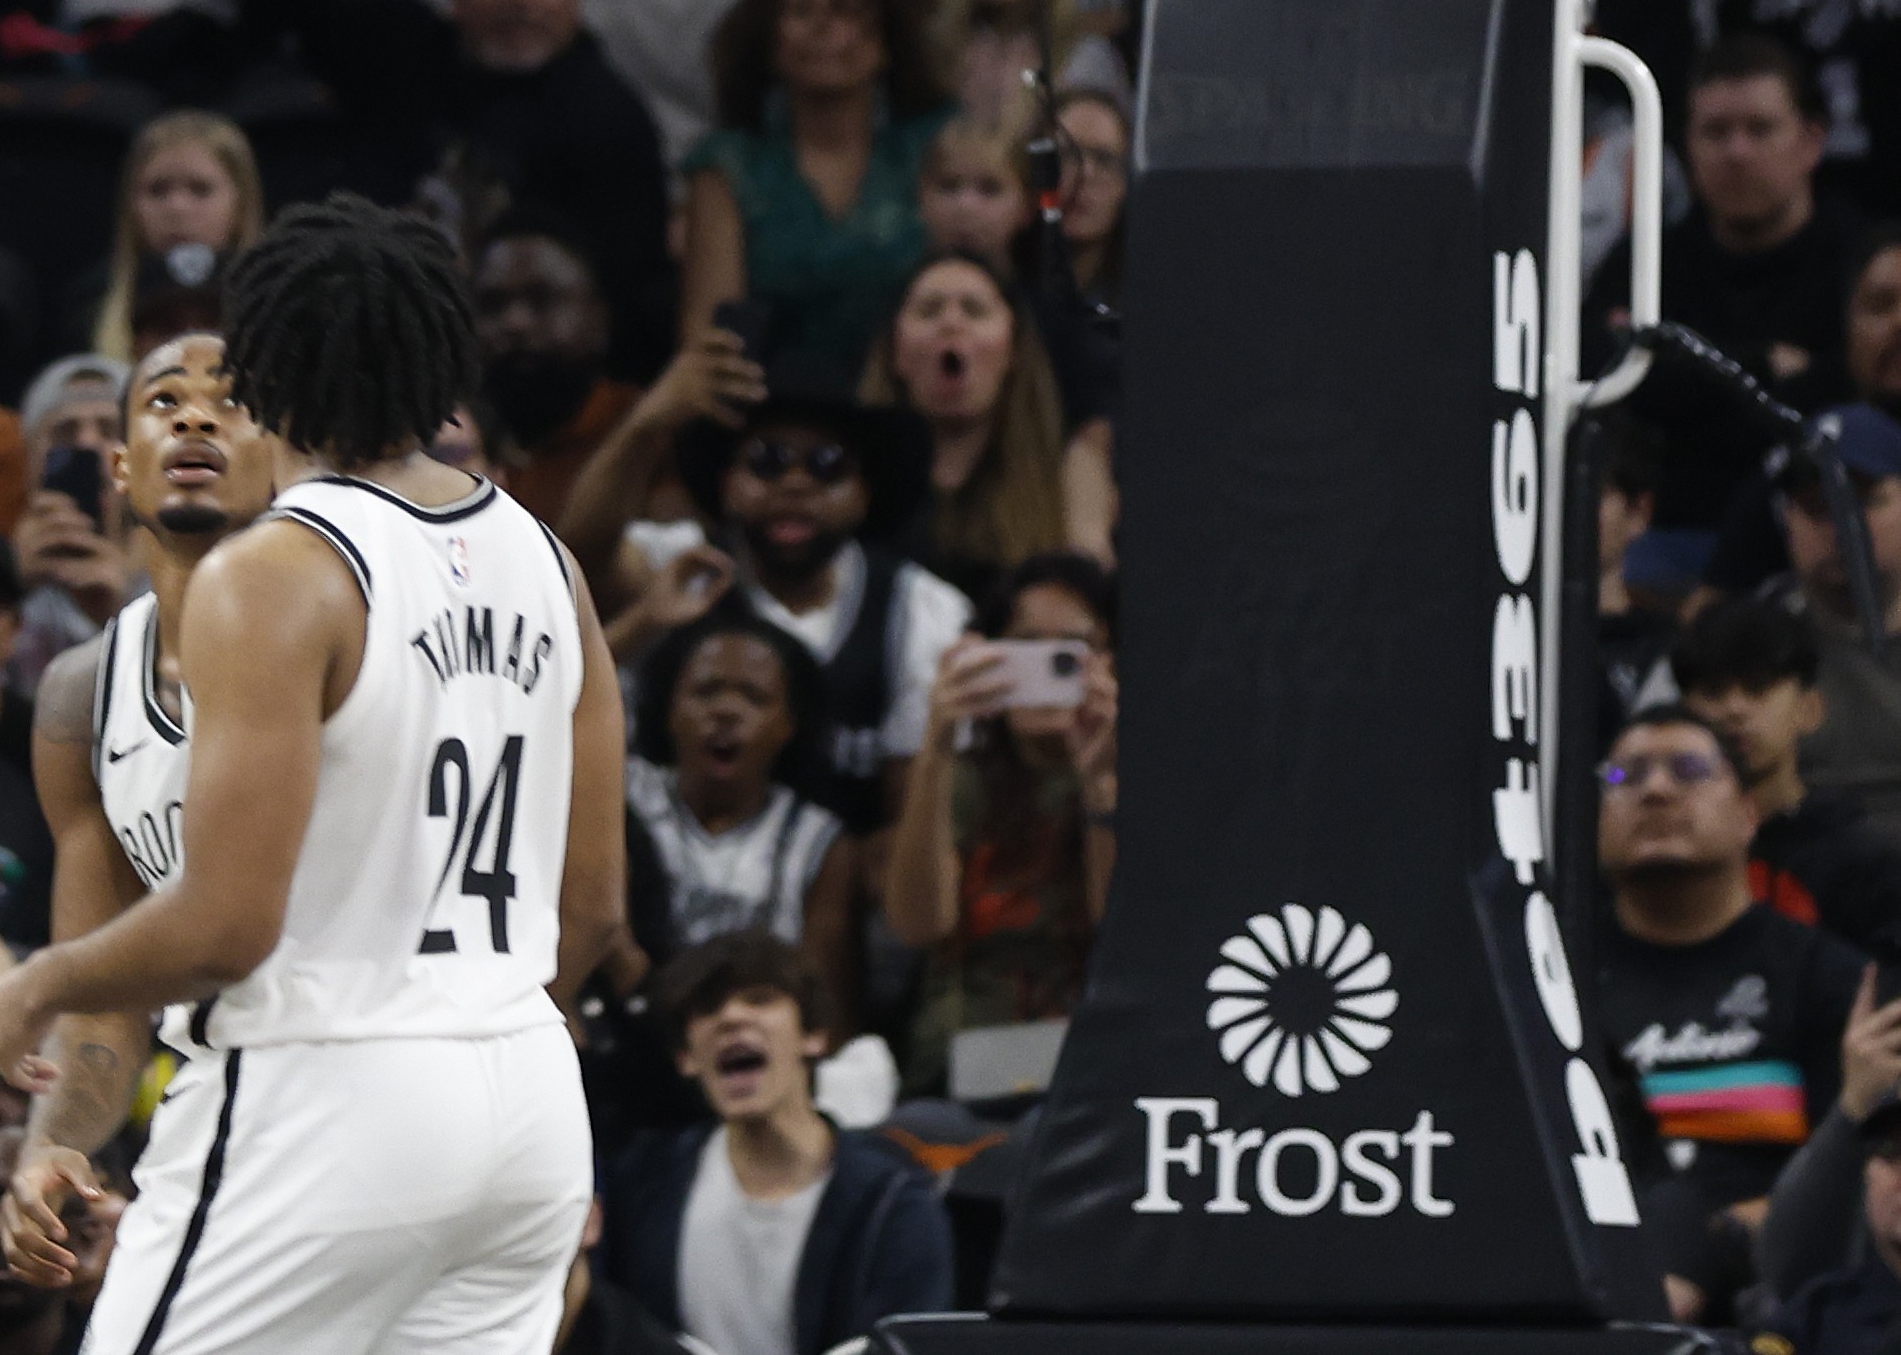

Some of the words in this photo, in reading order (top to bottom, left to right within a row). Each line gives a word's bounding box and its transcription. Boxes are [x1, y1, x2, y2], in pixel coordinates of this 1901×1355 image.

[416, 735, 525, 955] 24
[1492, 247, 1641, 1227] bet365
[1131, 1096, 1456, 1217] Frost
